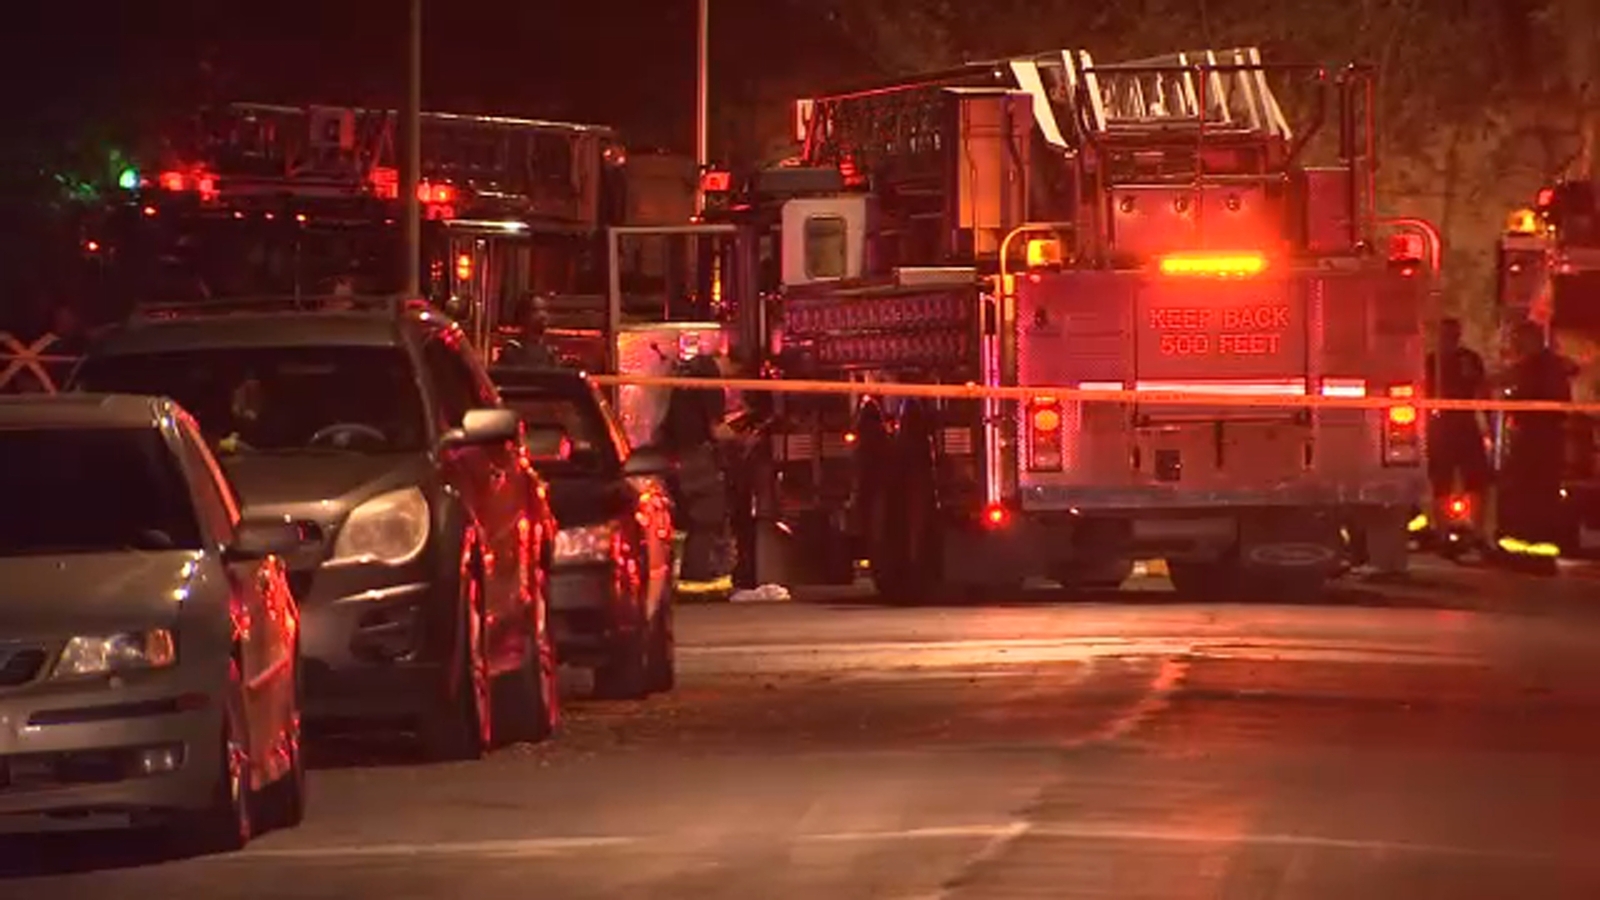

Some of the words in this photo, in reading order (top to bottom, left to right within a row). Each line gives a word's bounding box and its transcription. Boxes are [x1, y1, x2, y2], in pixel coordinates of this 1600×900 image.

[1149, 308, 1212, 329] KEEP
[1223, 306, 1289, 328] BACK
[1160, 334, 1209, 354] 500
[1219, 333, 1281, 354] FEET
